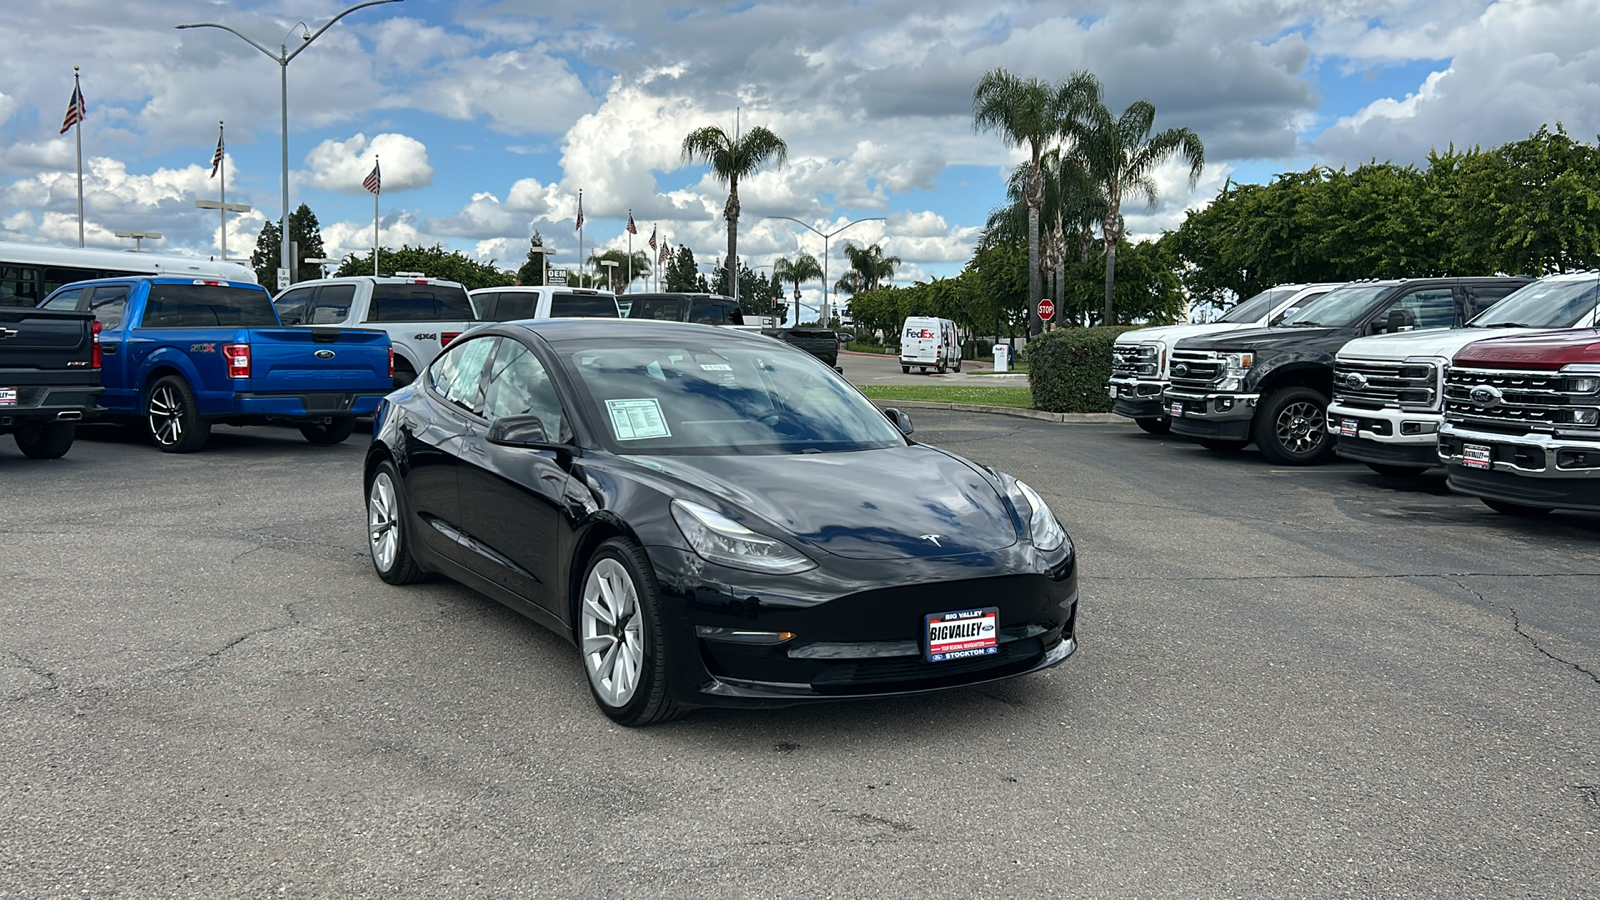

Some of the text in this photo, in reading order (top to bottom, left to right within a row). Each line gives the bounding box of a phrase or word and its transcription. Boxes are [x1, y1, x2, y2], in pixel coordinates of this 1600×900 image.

[548, 270, 567, 278] OEM
[1039, 305, 1053, 314] STOP
[906, 328, 935, 339] FedEx
[1460, 350, 1546, 361] SUPER DUTY
[959, 610, 982, 618] VALLEY
[930, 621, 983, 641] BIGVALLEY
[945, 648, 985, 660] STOCKTON
